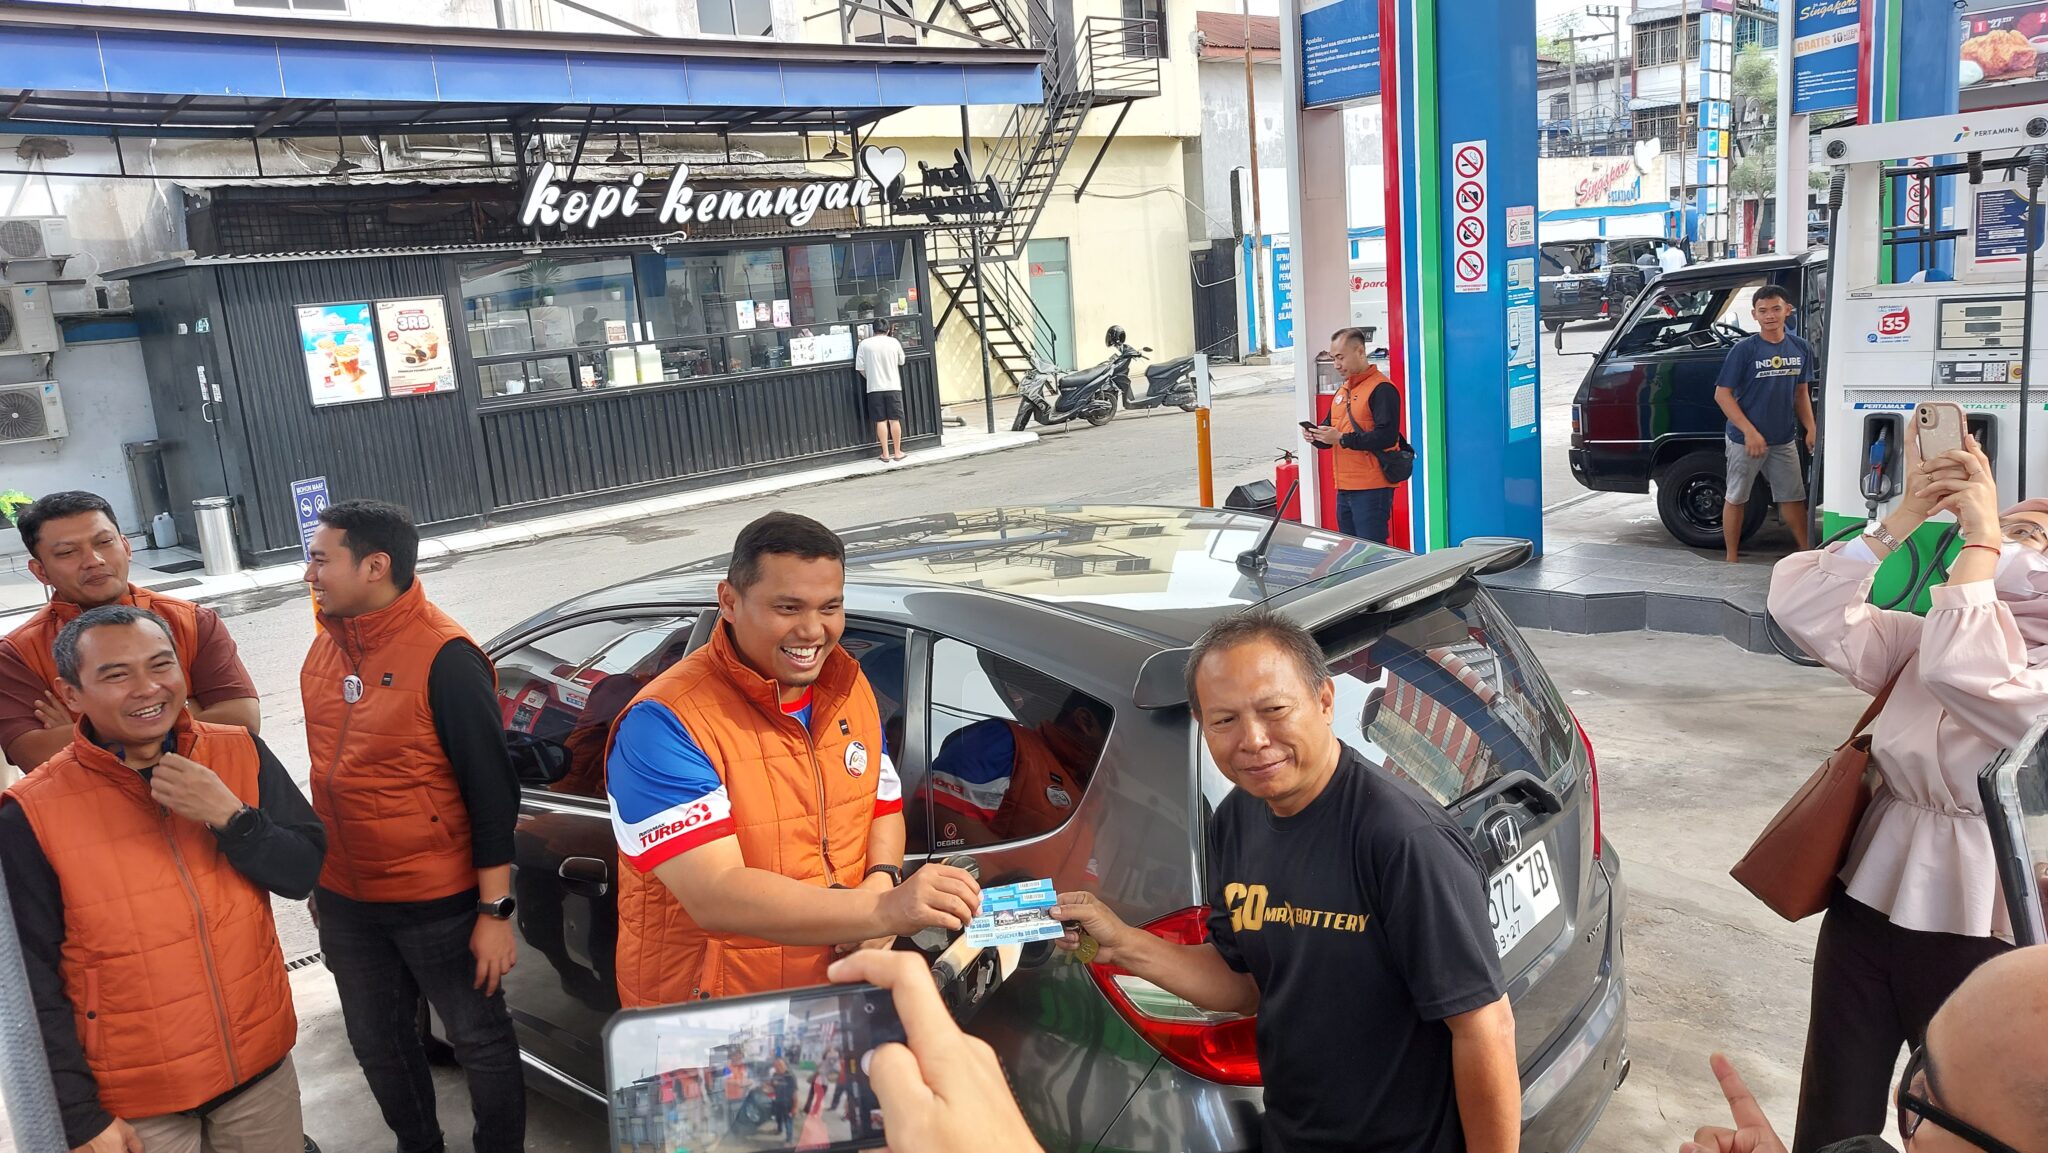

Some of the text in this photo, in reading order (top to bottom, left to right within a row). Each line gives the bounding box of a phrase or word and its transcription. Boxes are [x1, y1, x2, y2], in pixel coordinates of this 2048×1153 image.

[1799, 0, 1858, 21] Singapore
[1797, 36, 1831, 53] GRATIS
[1832, 32, 1843, 43] 10
[1974, 127, 2019, 137] PERTAMINA
[1577, 159, 1630, 206] Singapore
[520, 161, 644, 229] kopi
[658, 162, 874, 227] kenangan
[397, 315, 430, 331] 3RB
[1878, 316, 1906, 331] 135
[1755, 356, 1801, 369] INDOTUBE
[640, 814, 701, 848] TURBO
[937, 838, 965, 847] DEGREE
[1523, 849, 1549, 898] ZB
[1224, 882, 1268, 933] GO
